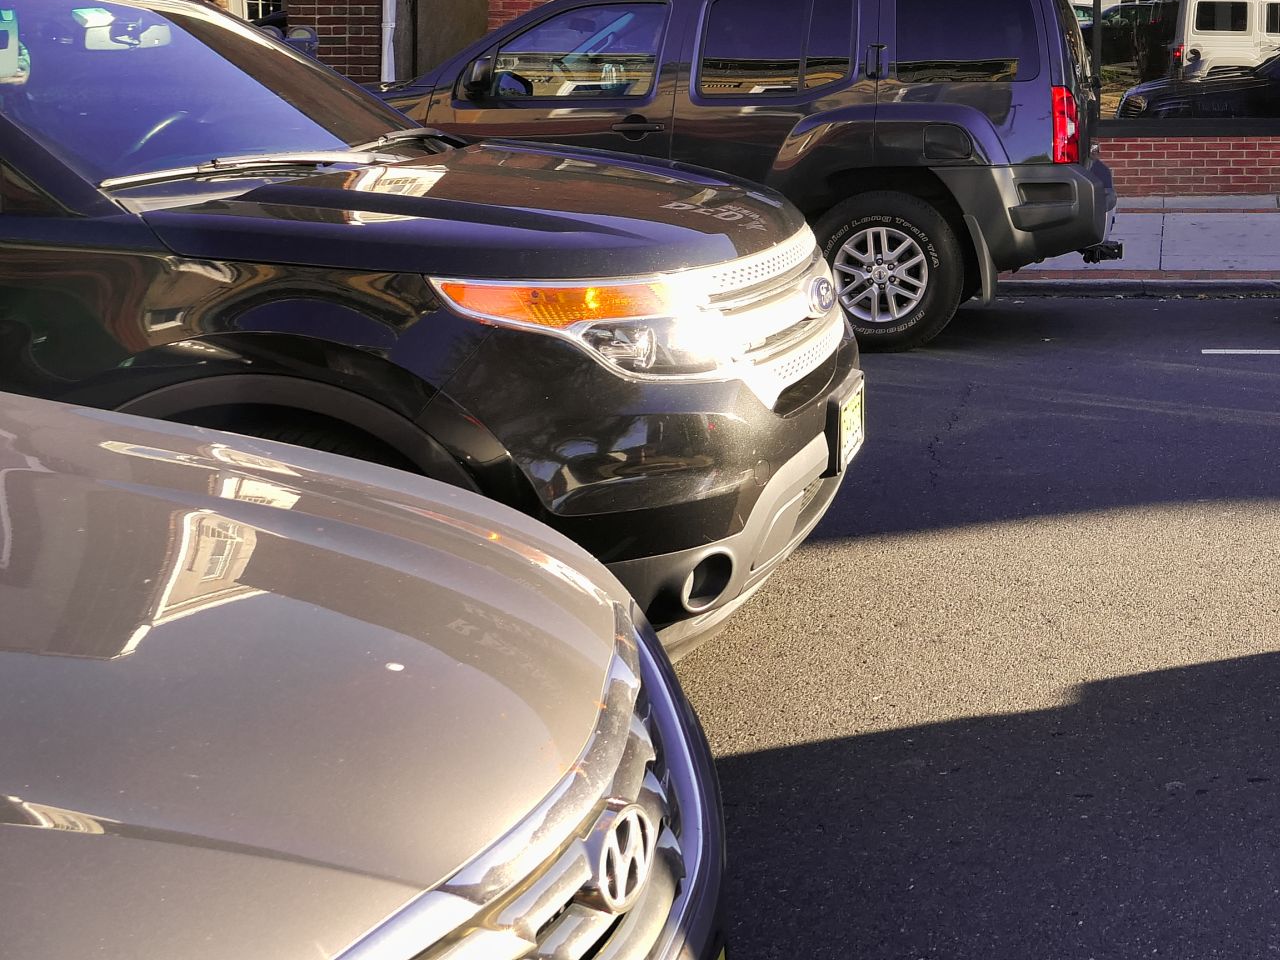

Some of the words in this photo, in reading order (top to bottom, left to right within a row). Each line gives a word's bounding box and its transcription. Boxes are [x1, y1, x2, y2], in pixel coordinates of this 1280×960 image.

[823, 224, 850, 258] adial
[851, 215, 893, 227] Long
[894, 216, 929, 242] Trail
